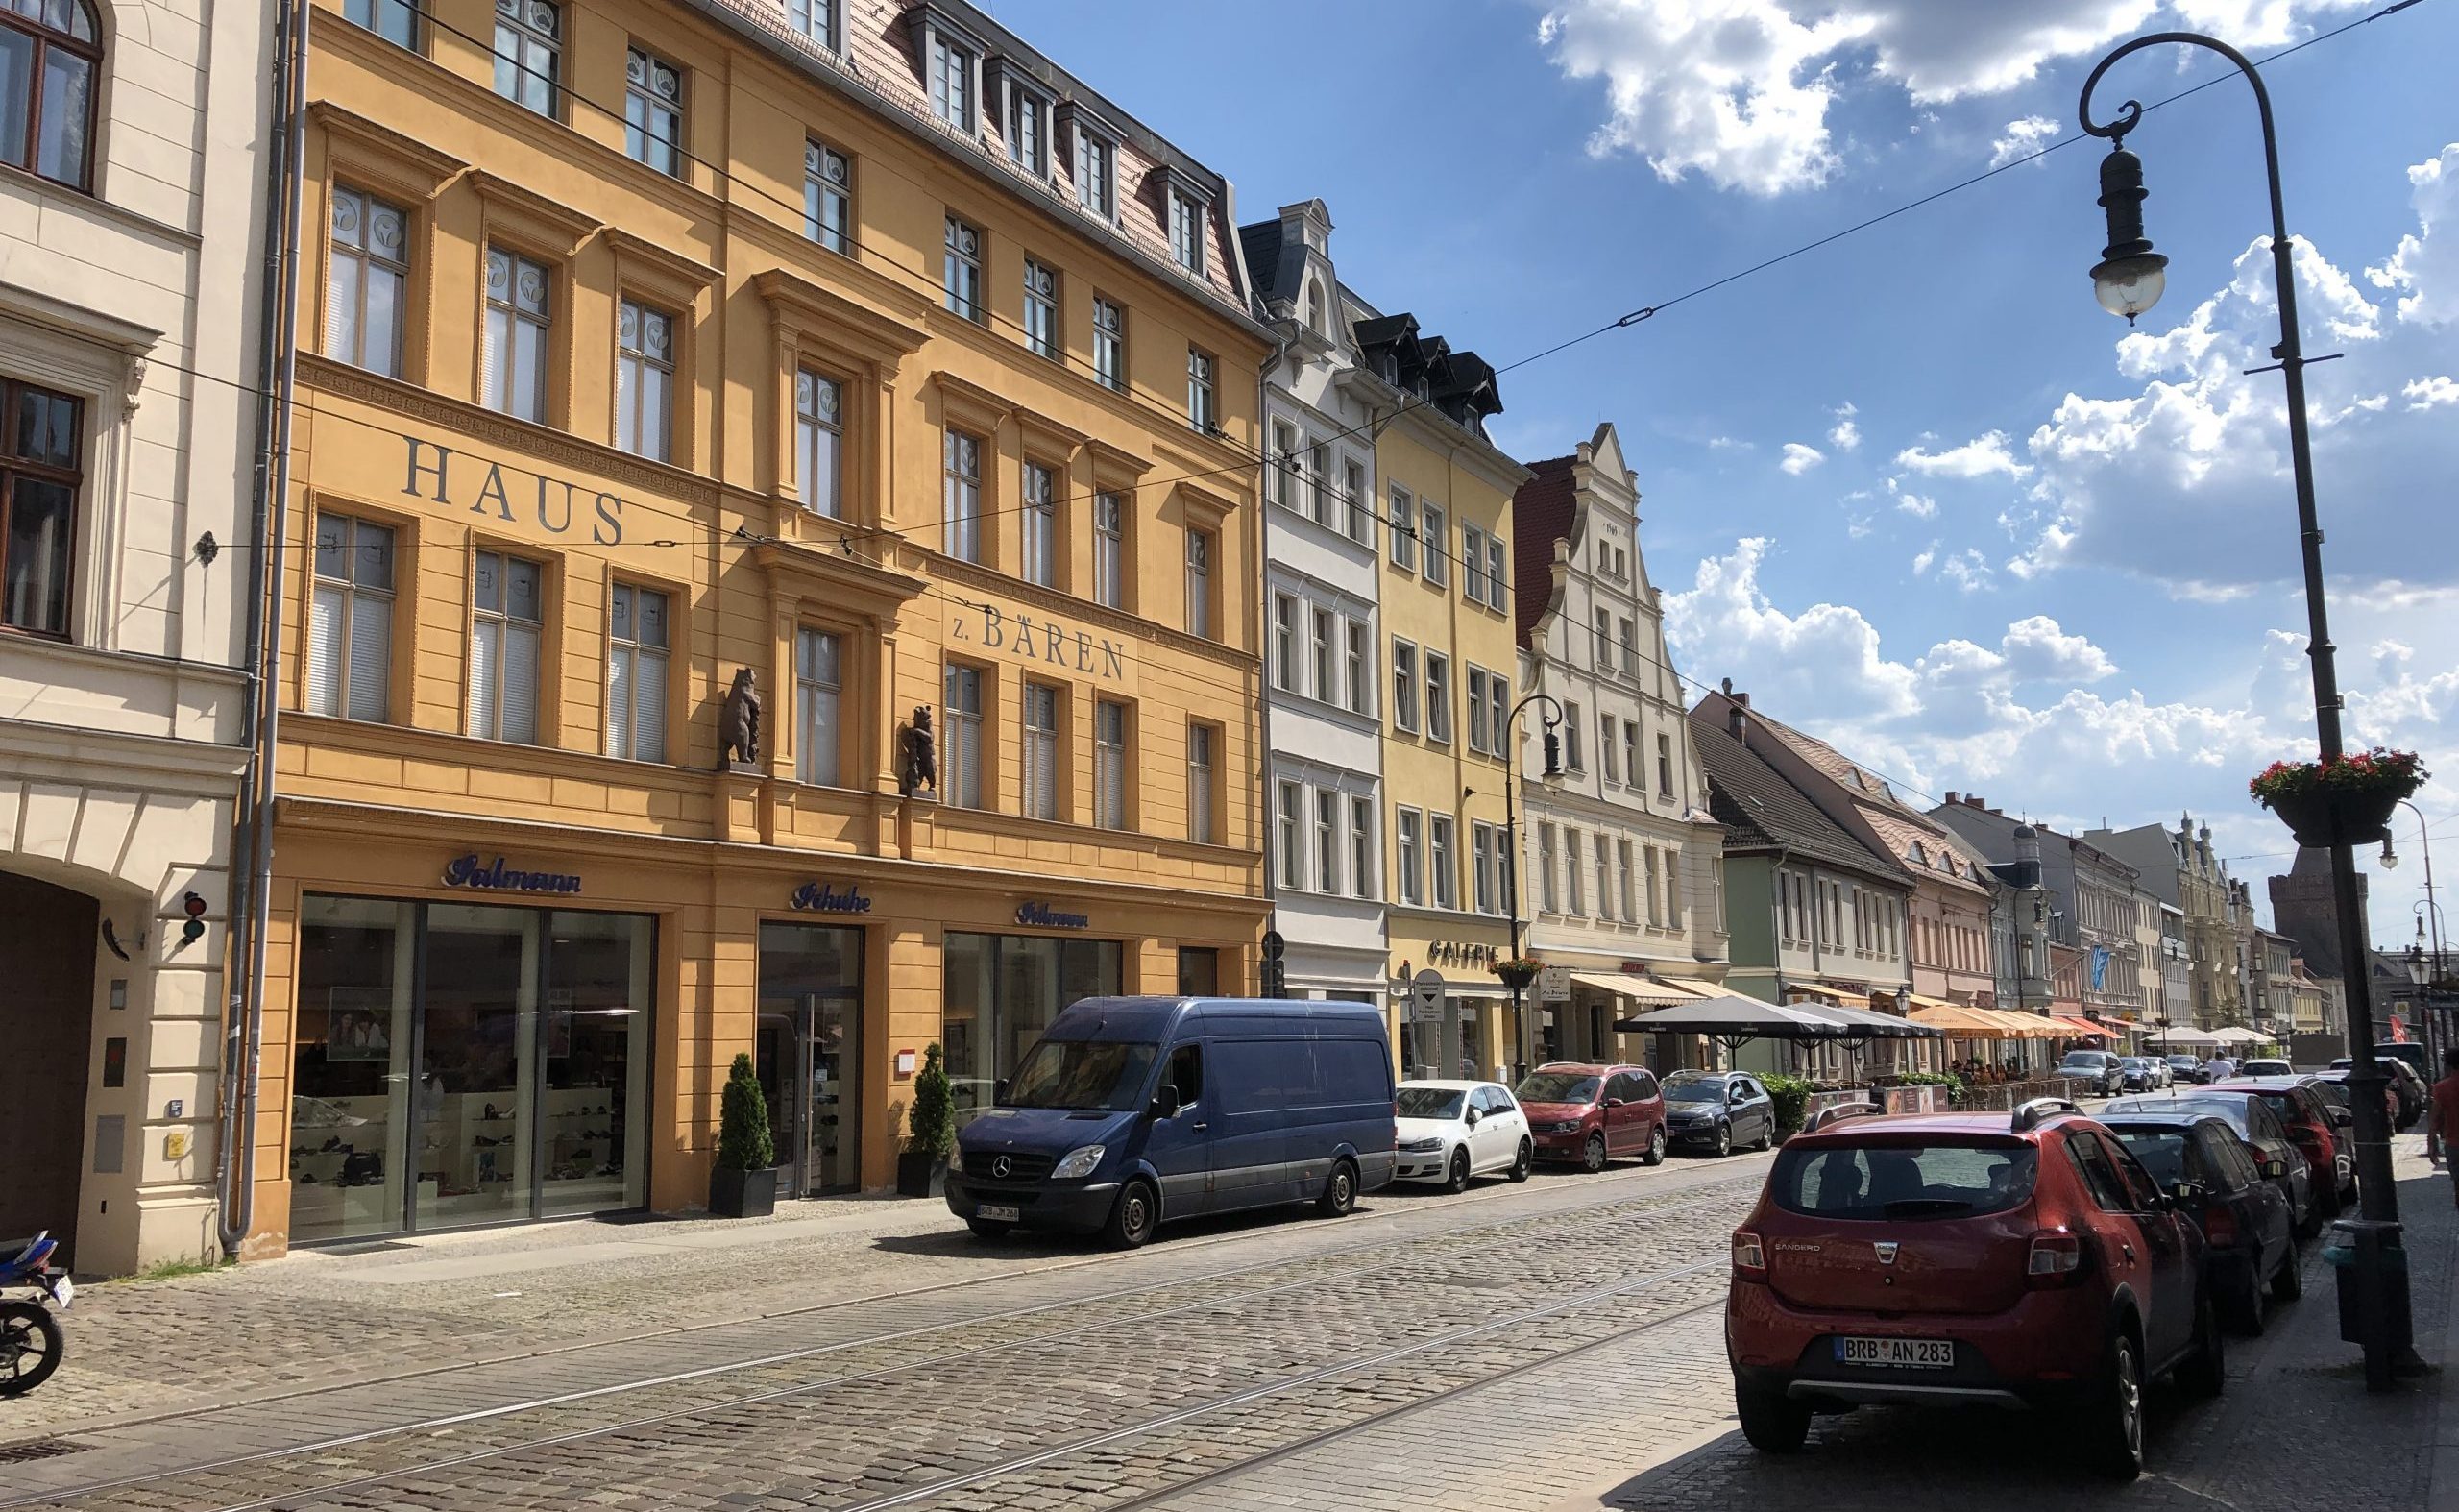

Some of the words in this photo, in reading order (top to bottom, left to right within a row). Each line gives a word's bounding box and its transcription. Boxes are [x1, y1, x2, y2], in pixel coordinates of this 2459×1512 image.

[401, 435, 623, 547] HAUS
[982, 605, 1124, 681] BÄREN
[789, 882, 871, 913] Schuhe
[1429, 939, 1499, 962] GALERIE
[1774, 1243, 1821, 1252] SANDERO
[1845, 1339, 1878, 1359] BRB
[1891, 1341, 1914, 1361] AN
[1918, 1343, 1952, 1363] 283
